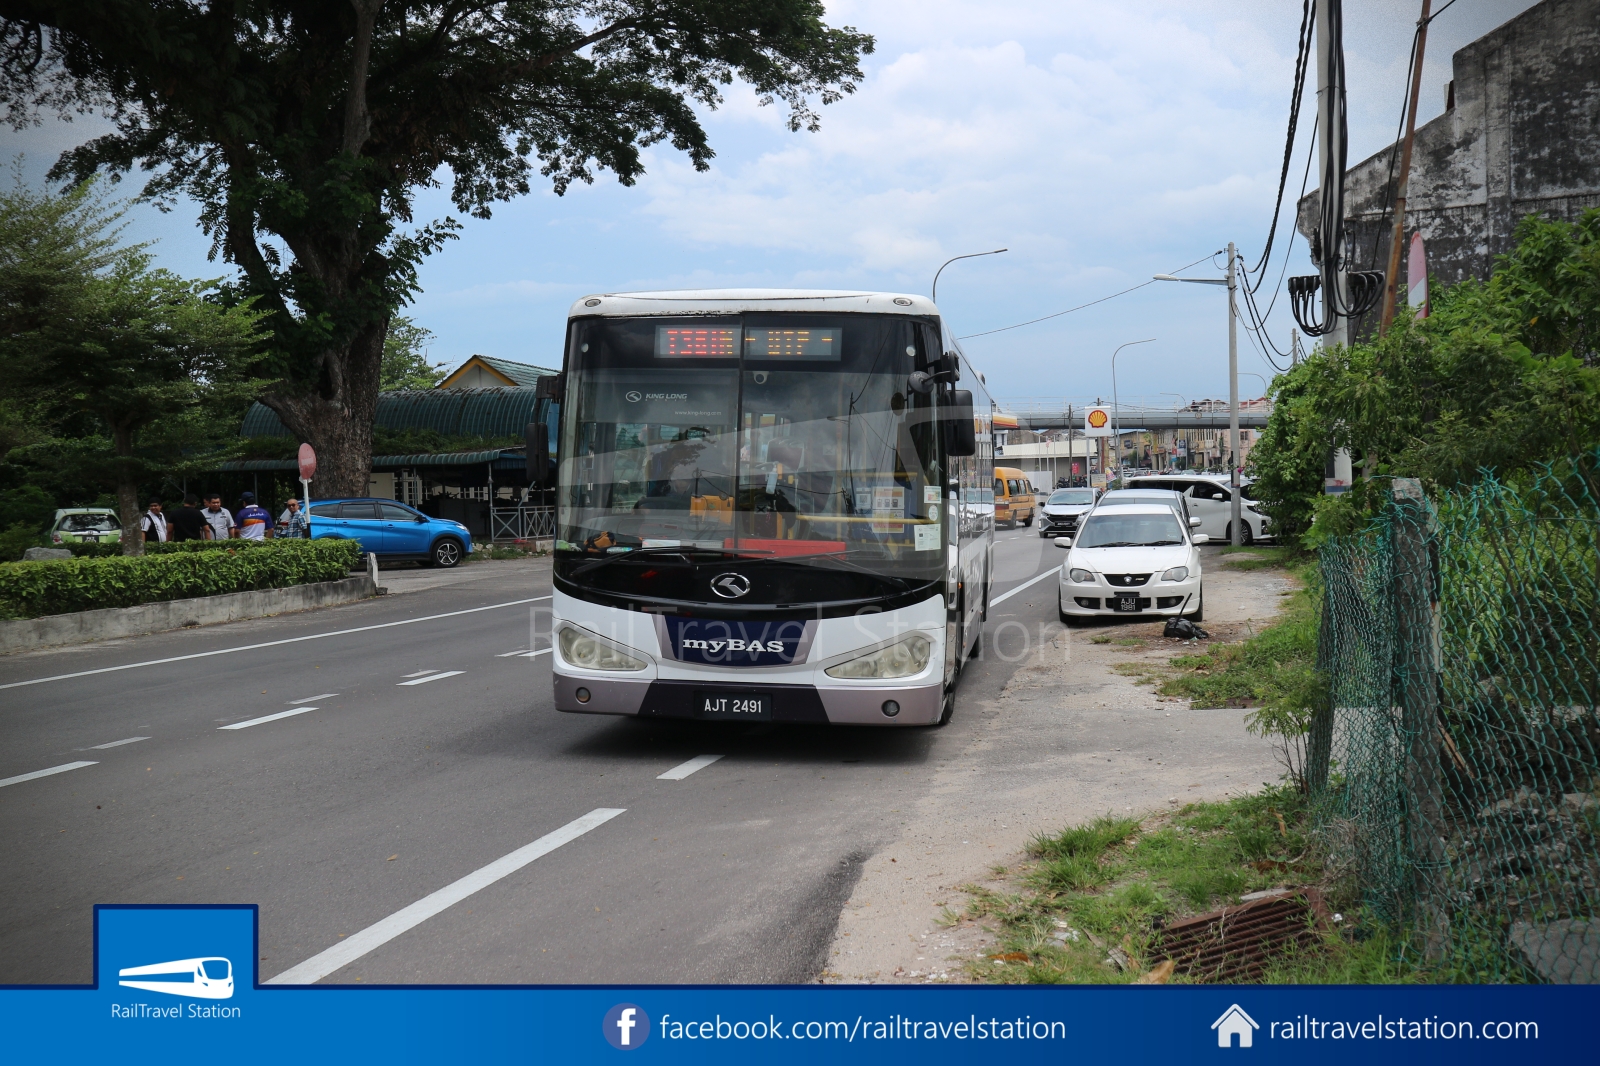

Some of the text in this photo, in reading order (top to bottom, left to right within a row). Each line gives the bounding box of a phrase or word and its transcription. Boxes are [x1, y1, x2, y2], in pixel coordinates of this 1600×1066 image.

[768, 331, 809, 355] UTP
[683, 639, 784, 653] myBAS
[704, 699, 762, 713] AJT 2491
